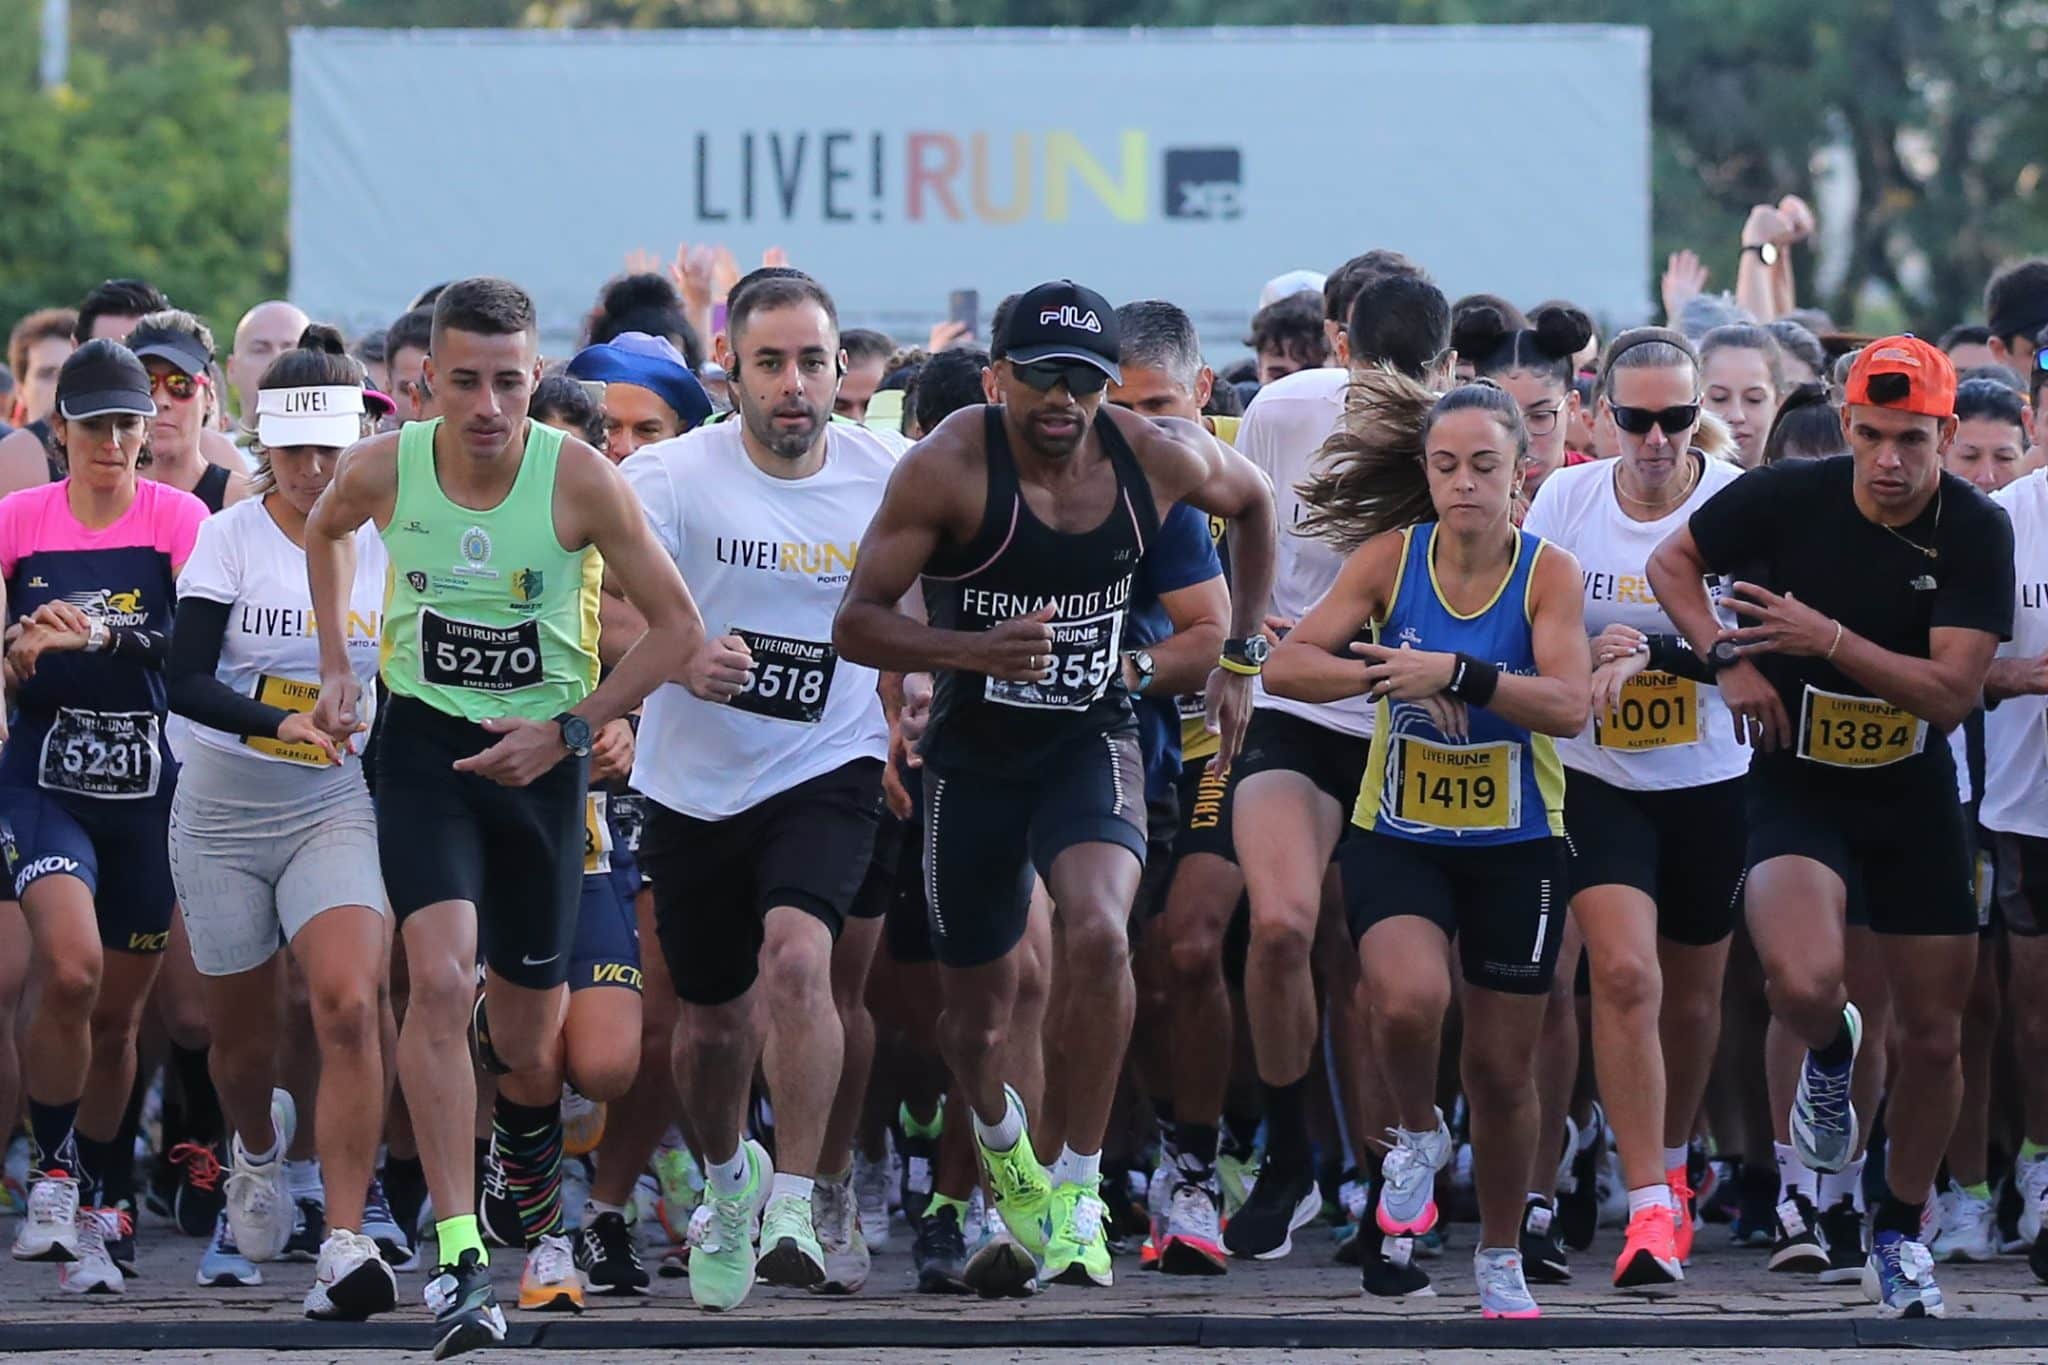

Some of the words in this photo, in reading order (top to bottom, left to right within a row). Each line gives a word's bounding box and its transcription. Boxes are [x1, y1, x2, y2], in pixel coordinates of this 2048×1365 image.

[1040, 305, 1102, 333] FILA
[285, 391, 328, 412] LIVE!
[817, 575, 849, 583] PORTO
[963, 588, 1100, 618] FERNANDO
[106, 612, 149, 626] ERKOV
[436, 642, 536, 676] 5270
[463, 680, 513, 689] EMERSON
[1046, 695, 1068, 703] LUIS
[1820, 719, 1908, 750] 1384
[63, 739, 141, 777] 5231
[275, 747, 319, 761] GABRIELA
[1416, 772, 1496, 809] 1419
